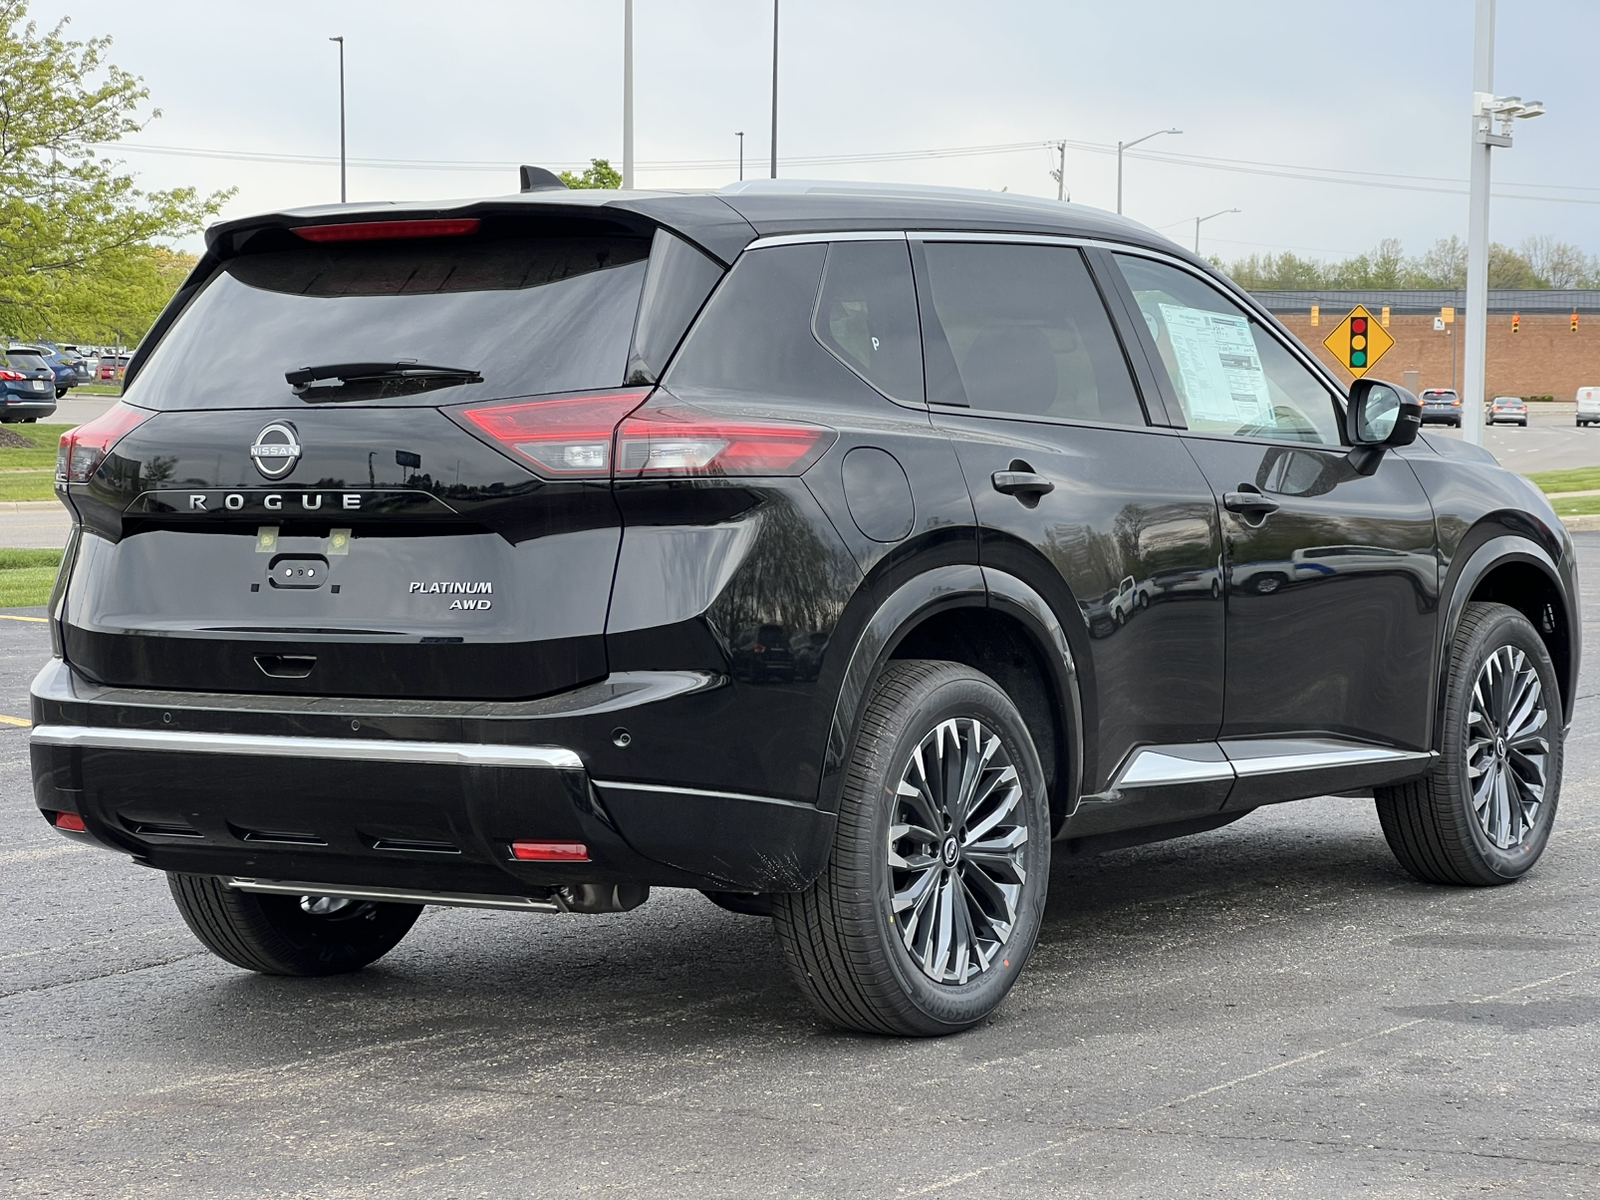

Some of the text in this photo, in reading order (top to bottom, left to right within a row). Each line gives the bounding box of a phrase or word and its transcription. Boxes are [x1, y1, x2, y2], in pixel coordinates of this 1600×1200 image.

[251, 446, 299, 456] NISSAN
[189, 493, 362, 511] ROGUE
[408, 581, 493, 594] PLATINUM
[448, 599, 492, 610] AWD
